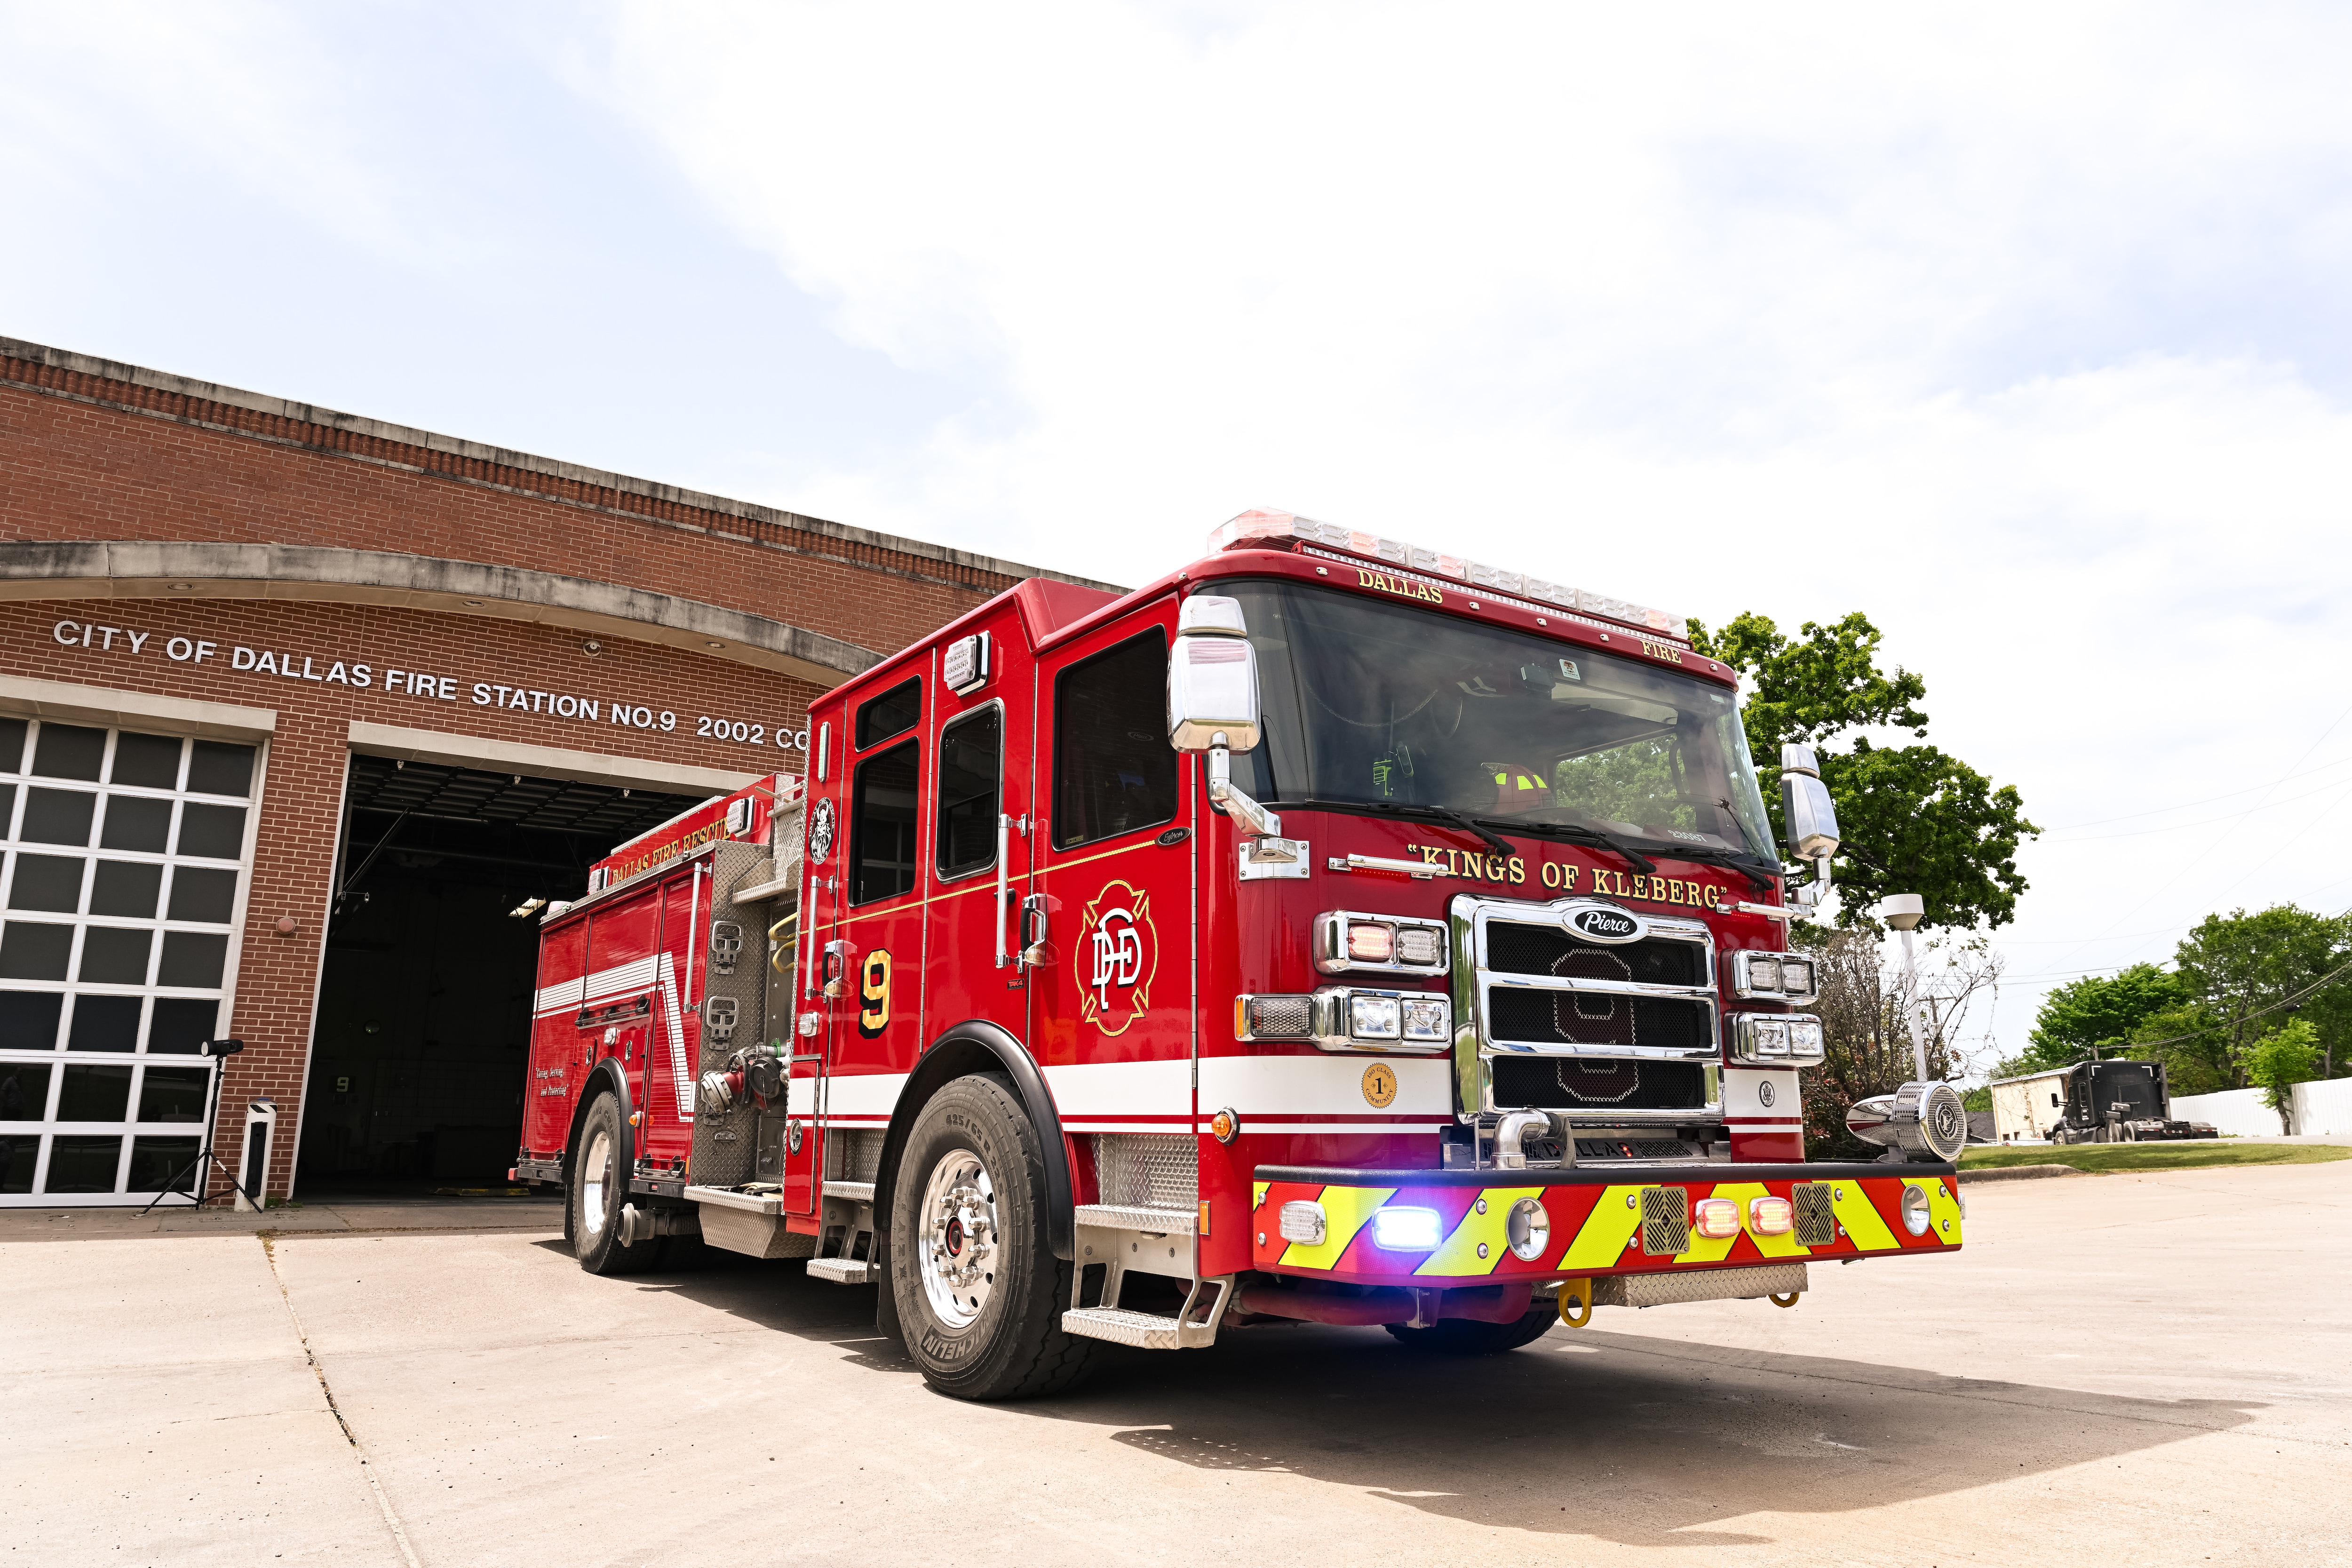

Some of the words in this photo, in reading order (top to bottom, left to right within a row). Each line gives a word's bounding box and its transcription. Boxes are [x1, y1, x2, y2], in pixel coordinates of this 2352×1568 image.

[1356, 569, 1443, 604] DALLAS
[1642, 640, 1682, 664] FIRE
[54, 620, 150, 654] CITY
[166, 637, 218, 664] OF
[231, 645, 372, 688] DALLAS
[385, 669, 458, 701] FIRE
[471, 683, 599, 721] STATION
[611, 703, 676, 732] NO.9
[696, 716, 765, 745] 2002
[1163, 830, 1184, 844] Enforcer
[1668, 829, 1707, 842] 23087
[612, 853, 649, 885] DALLAS
[652, 839, 680, 867] FIRE
[682, 816, 731, 852] RESCUE
[813, 856, 826, 865] ENGINE
[1541, 861, 1580, 891] OF
[1584, 911, 1630, 933] Pierce
[860, 949, 892, 1038] 9
[1376, 1067, 1391, 1079] CLASS
[337, 1076, 349, 1092] 9
[1375, 1077, 1384, 1094] 1
[1366, 1088, 1393, 1104] COMMUNITY
[983, 1139, 991, 1156] R
[1542, 1141, 1634, 1157] DLLAS
[922, 1307, 991, 1359] MICHELIN
